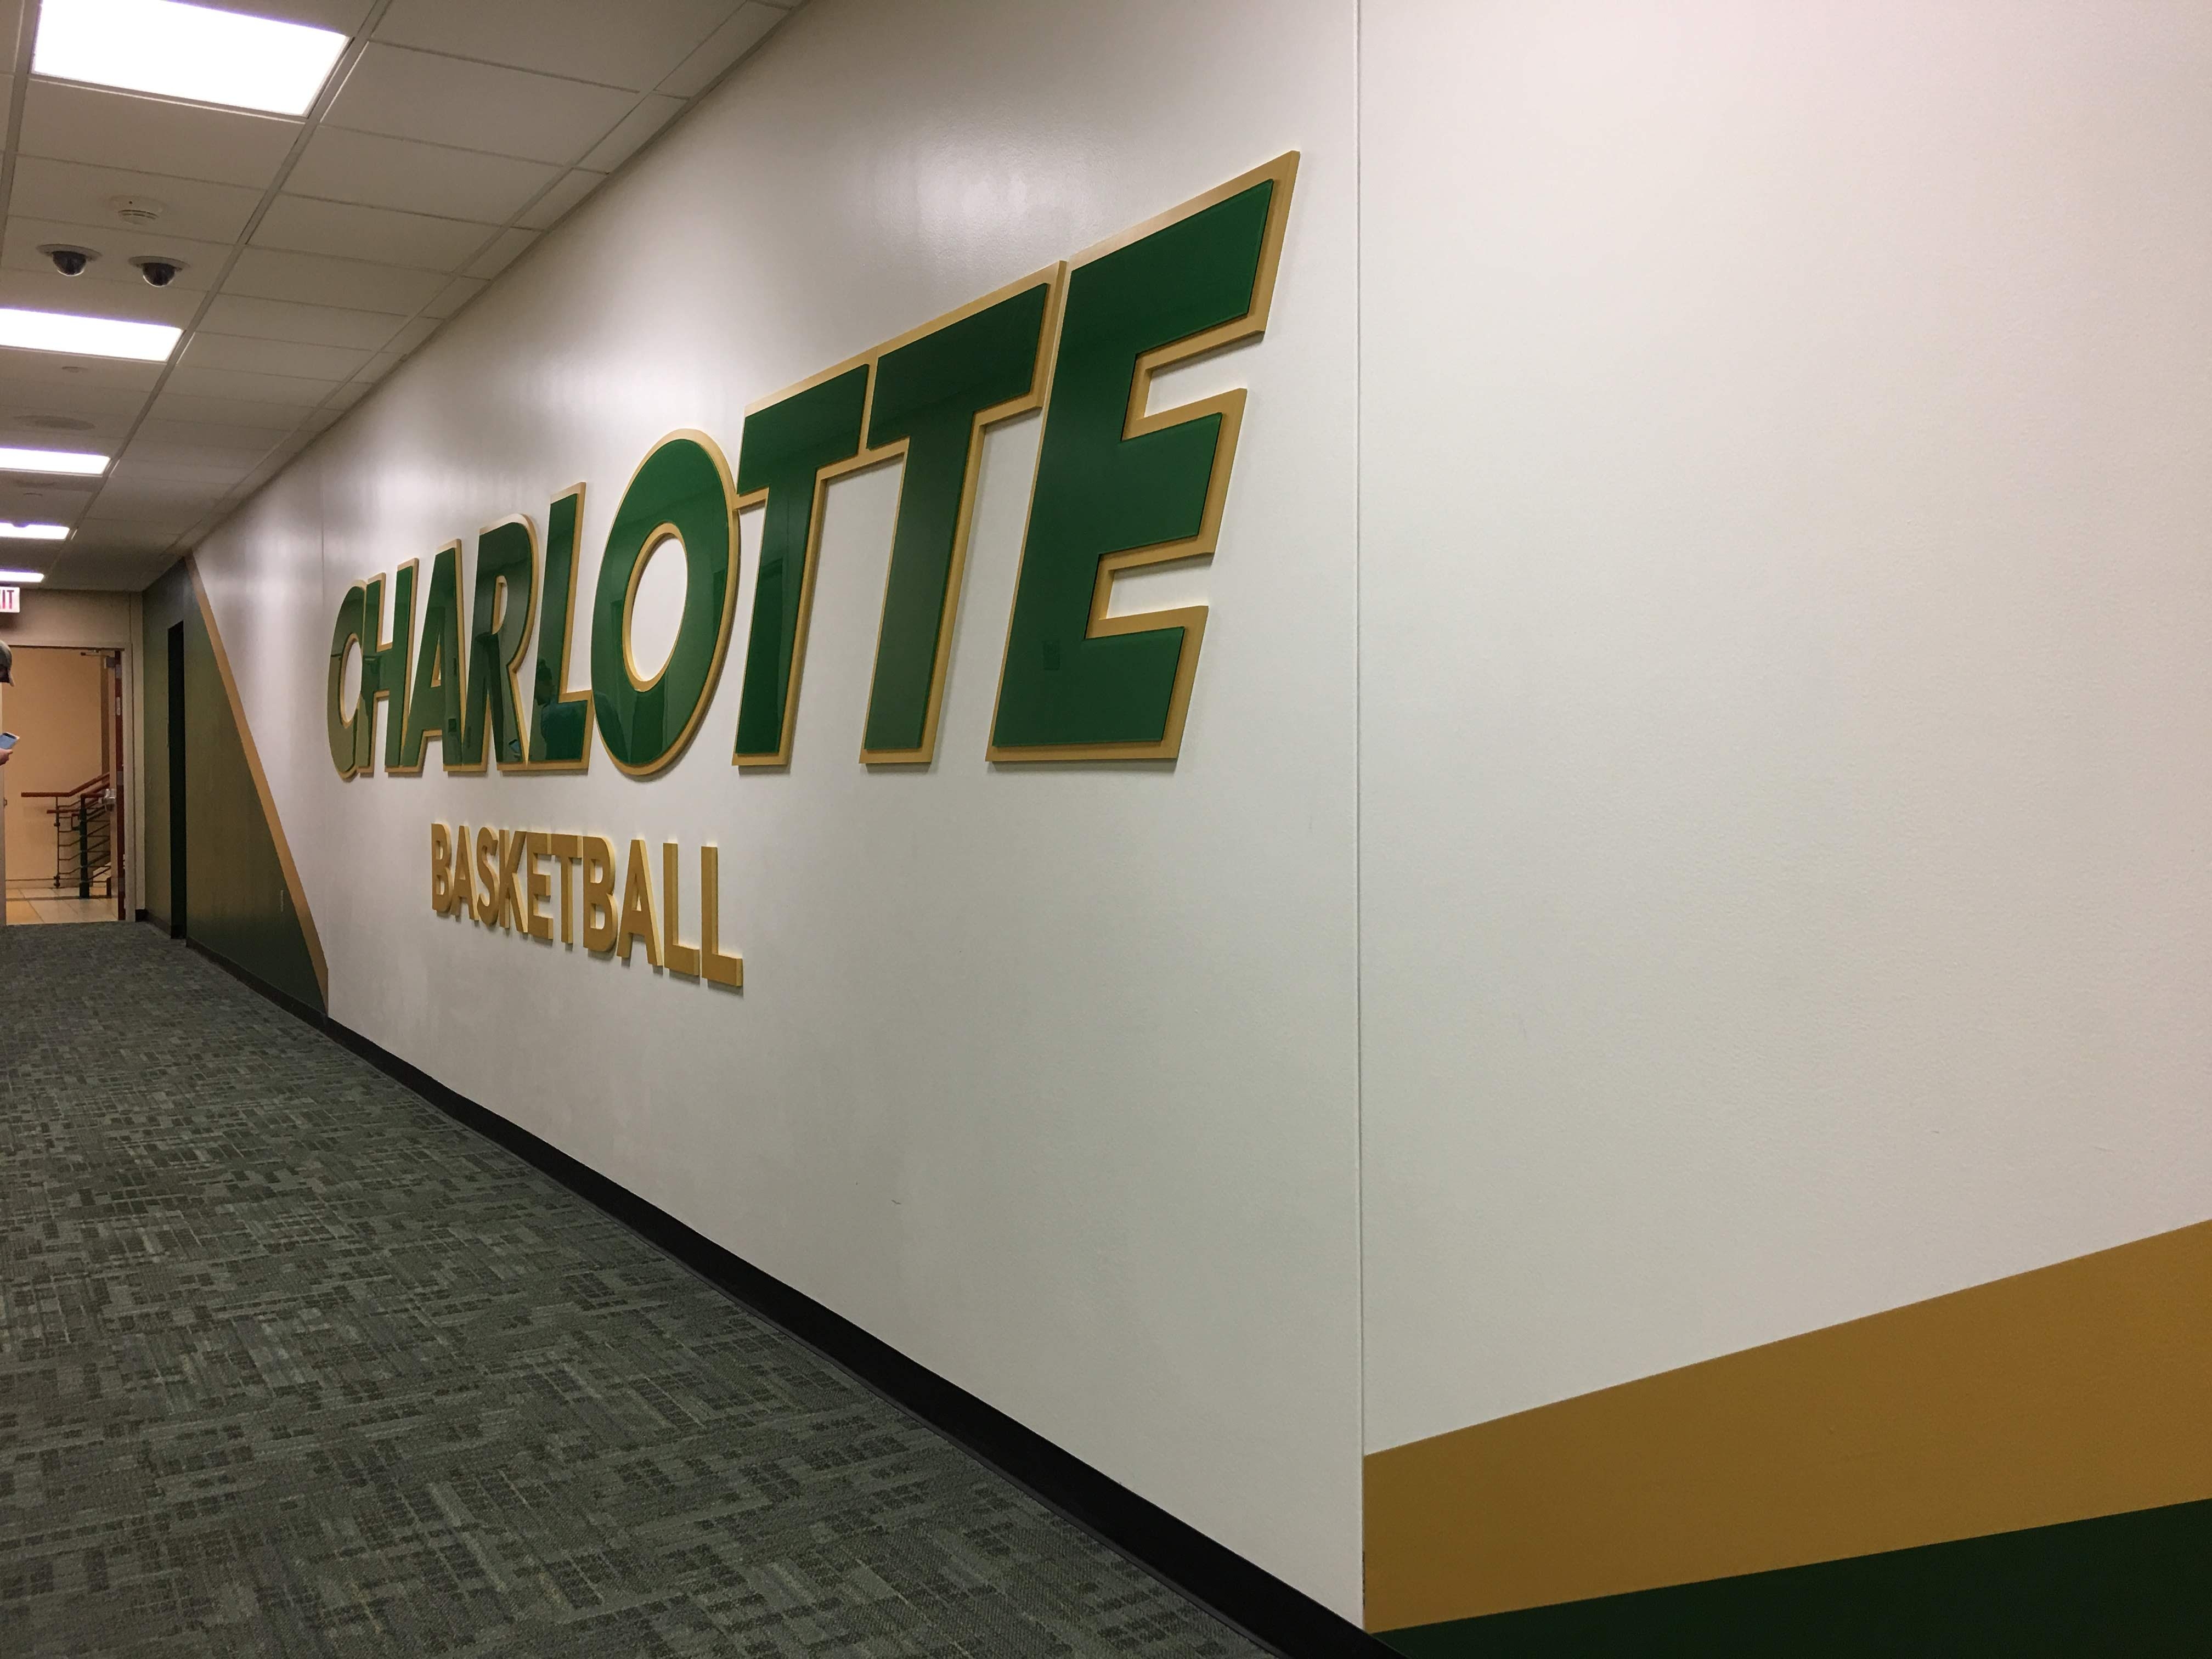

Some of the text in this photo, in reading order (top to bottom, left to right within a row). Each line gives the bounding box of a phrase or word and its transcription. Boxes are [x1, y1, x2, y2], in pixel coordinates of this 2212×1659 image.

[328, 151, 1300, 778] CHARLOTTE
[0, 590, 14, 609] IT
[431, 823, 743, 986] BASKETBALL
